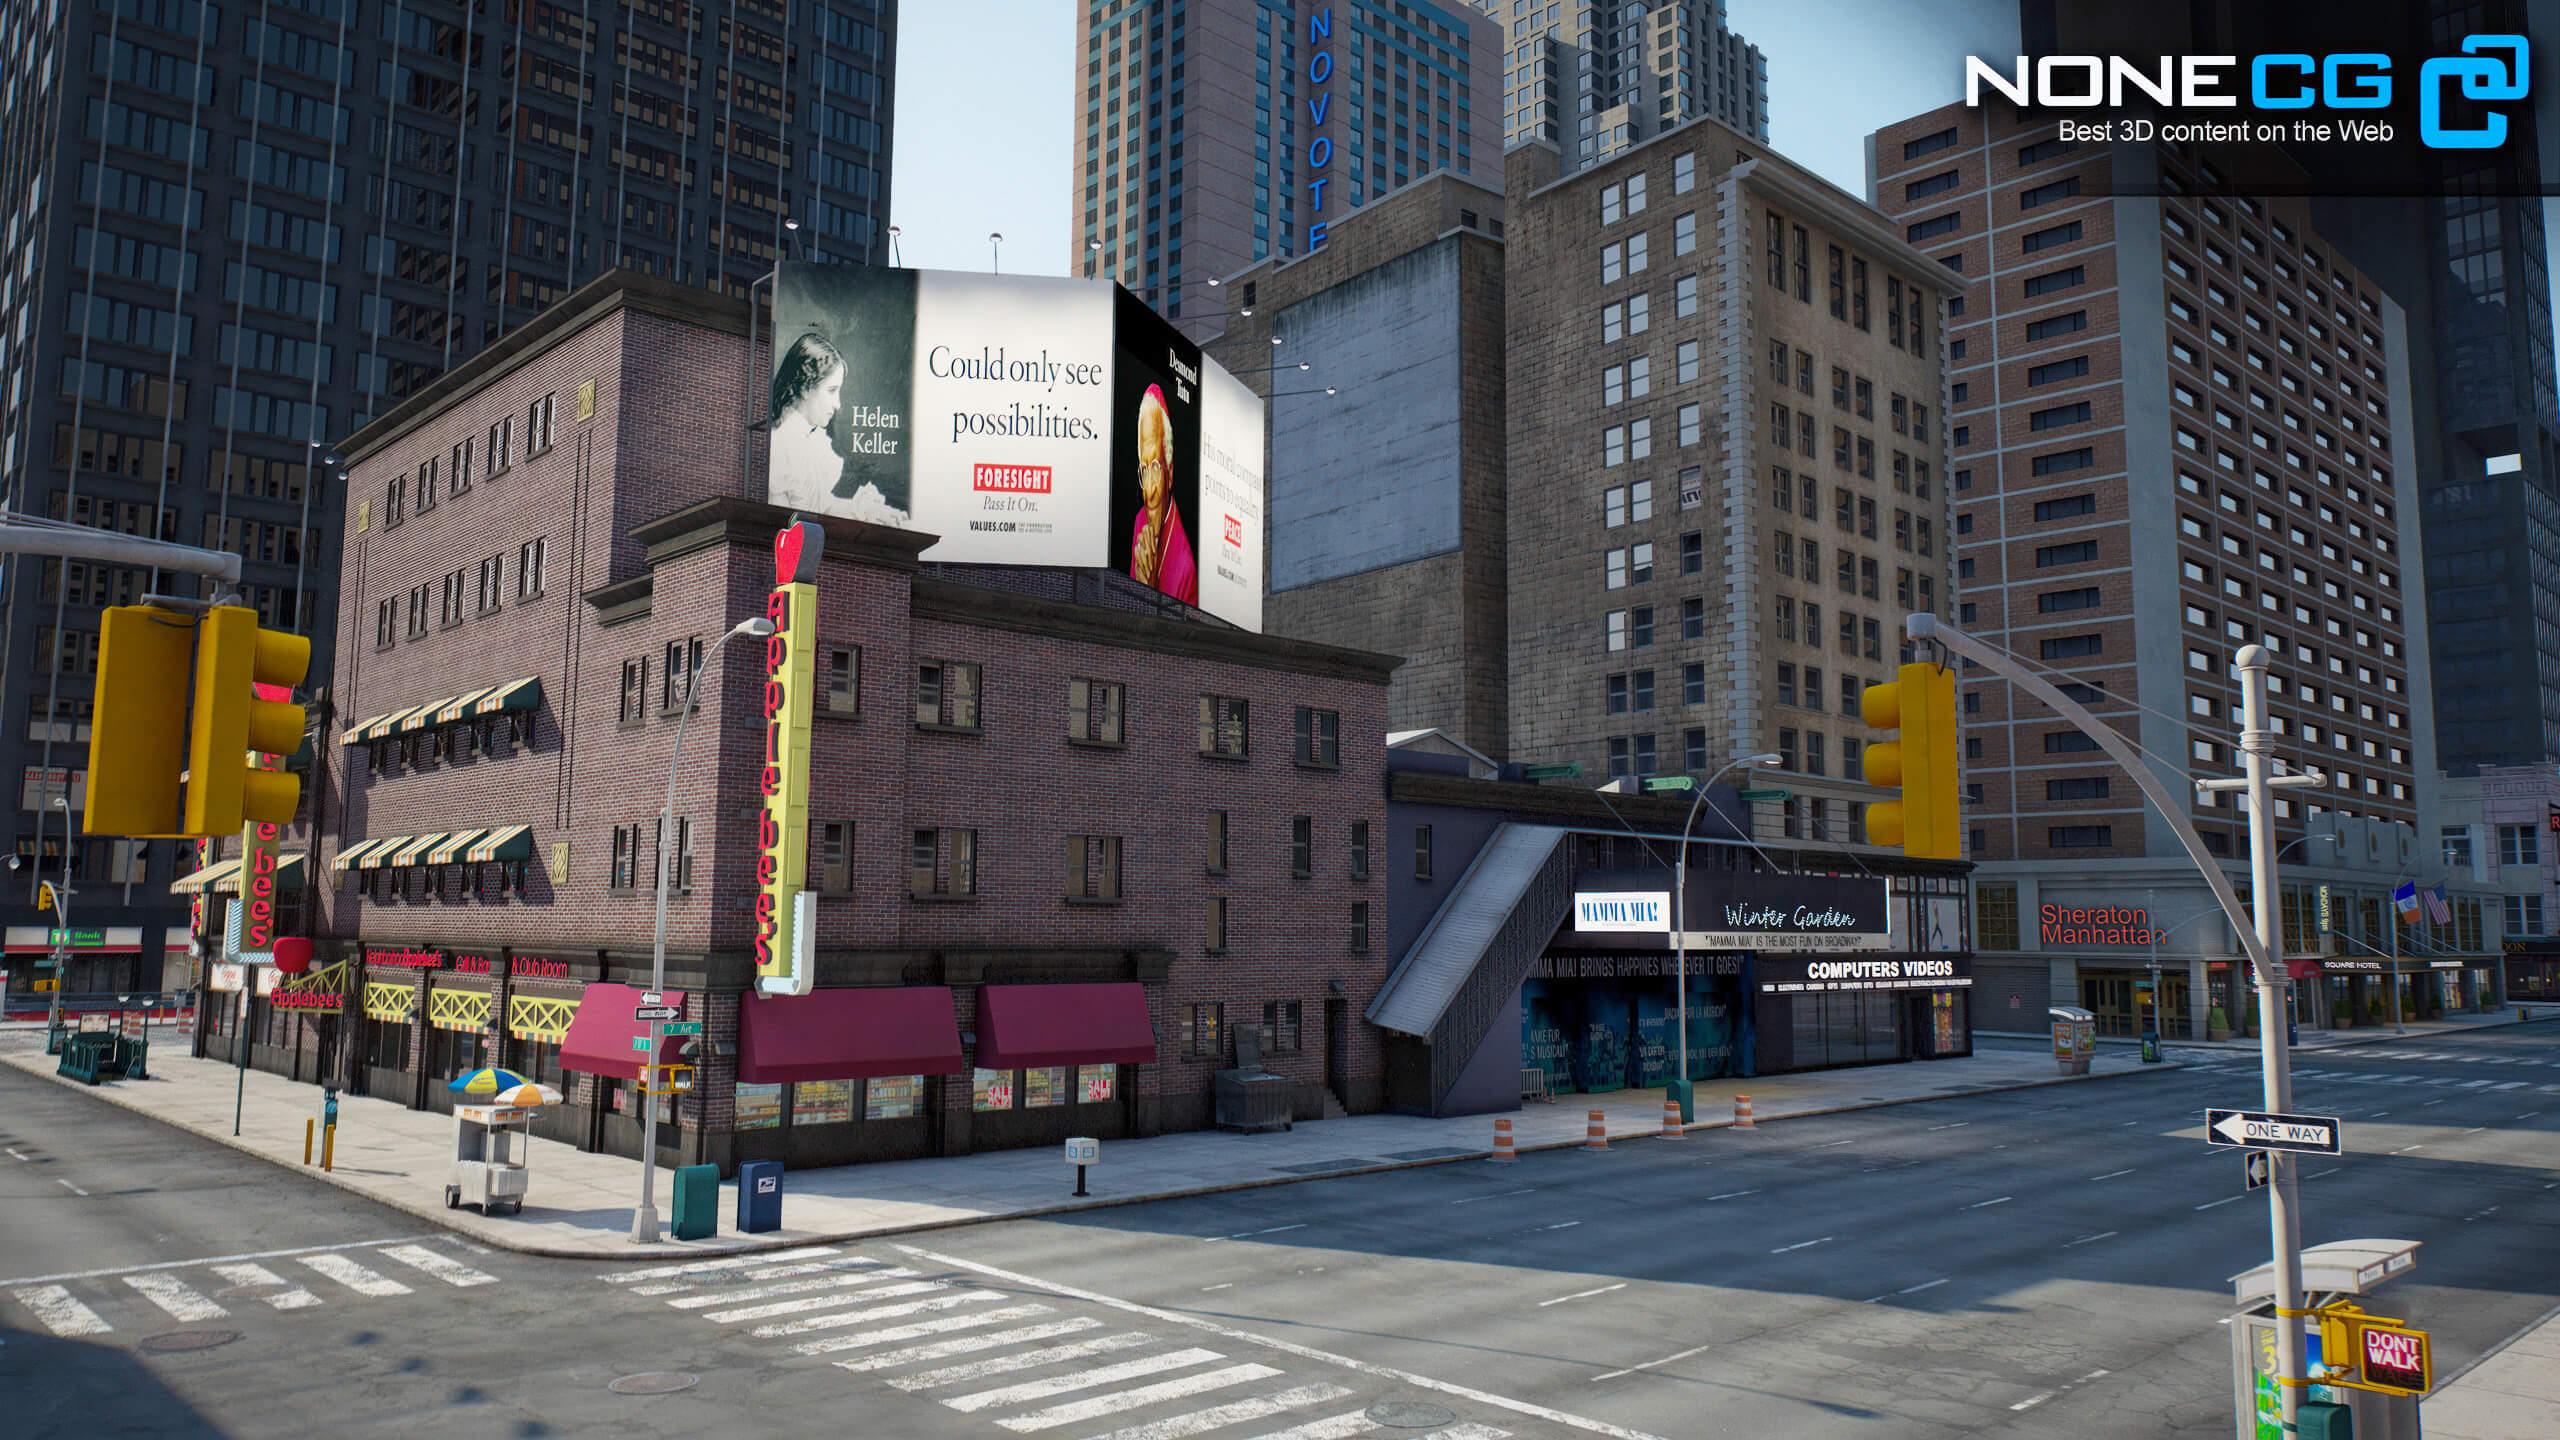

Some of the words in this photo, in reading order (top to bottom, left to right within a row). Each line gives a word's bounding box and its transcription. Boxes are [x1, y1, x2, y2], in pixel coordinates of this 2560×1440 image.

[929, 346, 1005, 380] Could
[1009, 350, 1061, 392] only
[1065, 362, 1102, 386] see
[1169, 347, 1197, 386] Desmond
[1176, 377, 1190, 404] Tutu
[852, 406, 899, 429] Helen
[952, 402, 1098, 443] possibilities.
[852, 432, 898, 454] Keller
[976, 467, 1049, 490] FORESIGHT
[984, 496, 1005, 511] Pass
[1007, 496, 1015, 511] It
[1018, 497, 1038, 512] On.
[969, 520, 1016, 532] VALUES.COM
[1581, 902, 1627, 921] MAMMA
[1630, 902, 1657, 921] MIA!
[2320, 885, 2328, 917] MONDAYS
[1725, 902, 1787, 928] Winter
[1793, 905, 1855, 929] Garden
[2041, 904, 2147, 924] Sheraton
[1756, 935, 1763, 946] IS
[1765, 935, 1778, 946] THE
[1779, 935, 1797, 946] MOST
[1800, 935, 1812, 946] FUN
[1814, 935, 1824, 946] ON
[2042, 924, 2167, 944] Manhattan
[512, 957, 518, 975] &
[519, 957, 540, 977] Club
[541, 958, 567, 978] Room
[1580, 956, 1614, 977] BRINGS
[1617, 956, 1659, 976] HAPPINES
[1660, 955, 1705, 976] WHEEVER
[1707, 956, 1714, 975] IT
[1808, 961, 1899, 979] COMPUTERS
[1902, 960, 1953, 976] VIDEOS
[2324, 961, 2355, 969] SQUARE
[2246, 1123, 2280, 1138] ONE
[2288, 1126, 2324, 1141] WAY
[2367, 1331, 2420, 1354] DONT
[2368, 1348, 2421, 1372] WALK
